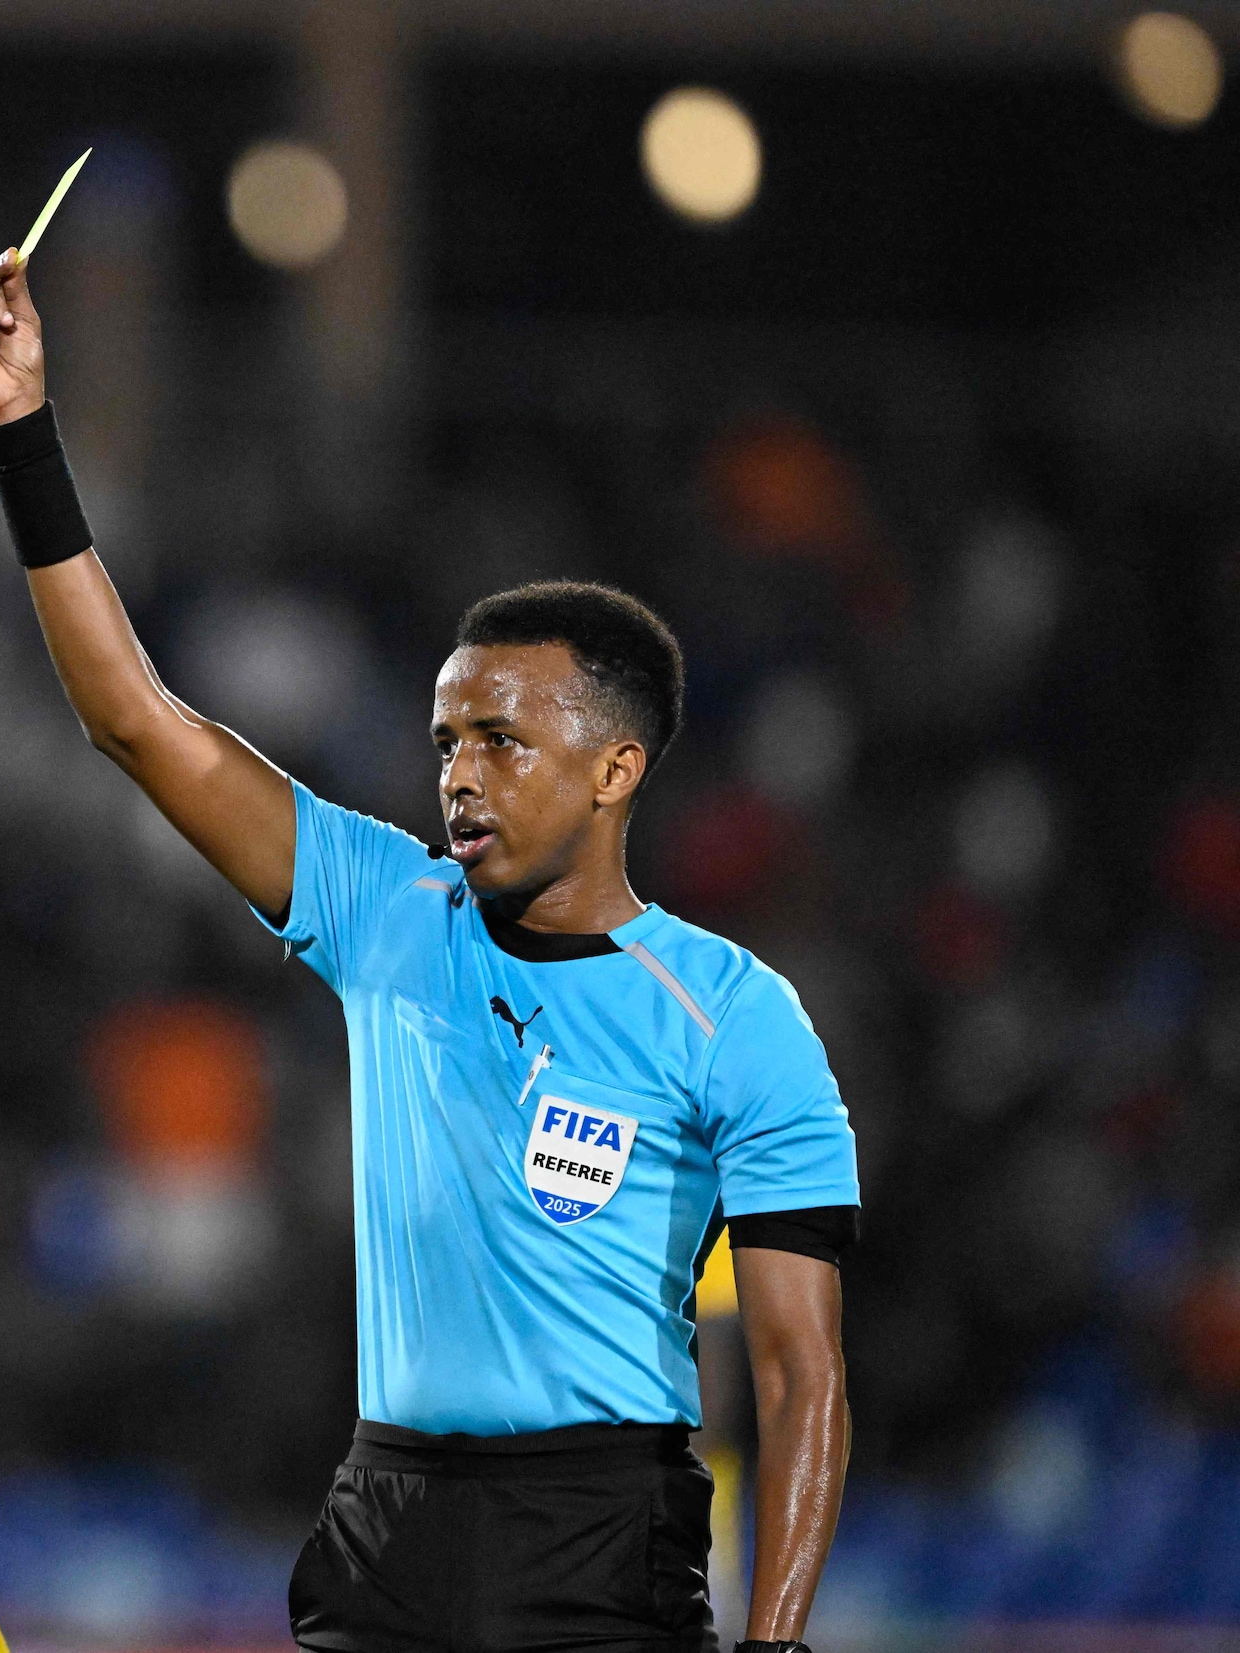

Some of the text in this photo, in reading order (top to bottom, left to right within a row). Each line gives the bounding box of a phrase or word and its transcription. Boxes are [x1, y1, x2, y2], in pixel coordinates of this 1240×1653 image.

[542, 1105, 621, 1152] FIFA
[532, 1152, 614, 1186] REFEREE
[544, 1196, 581, 1217] 2025
